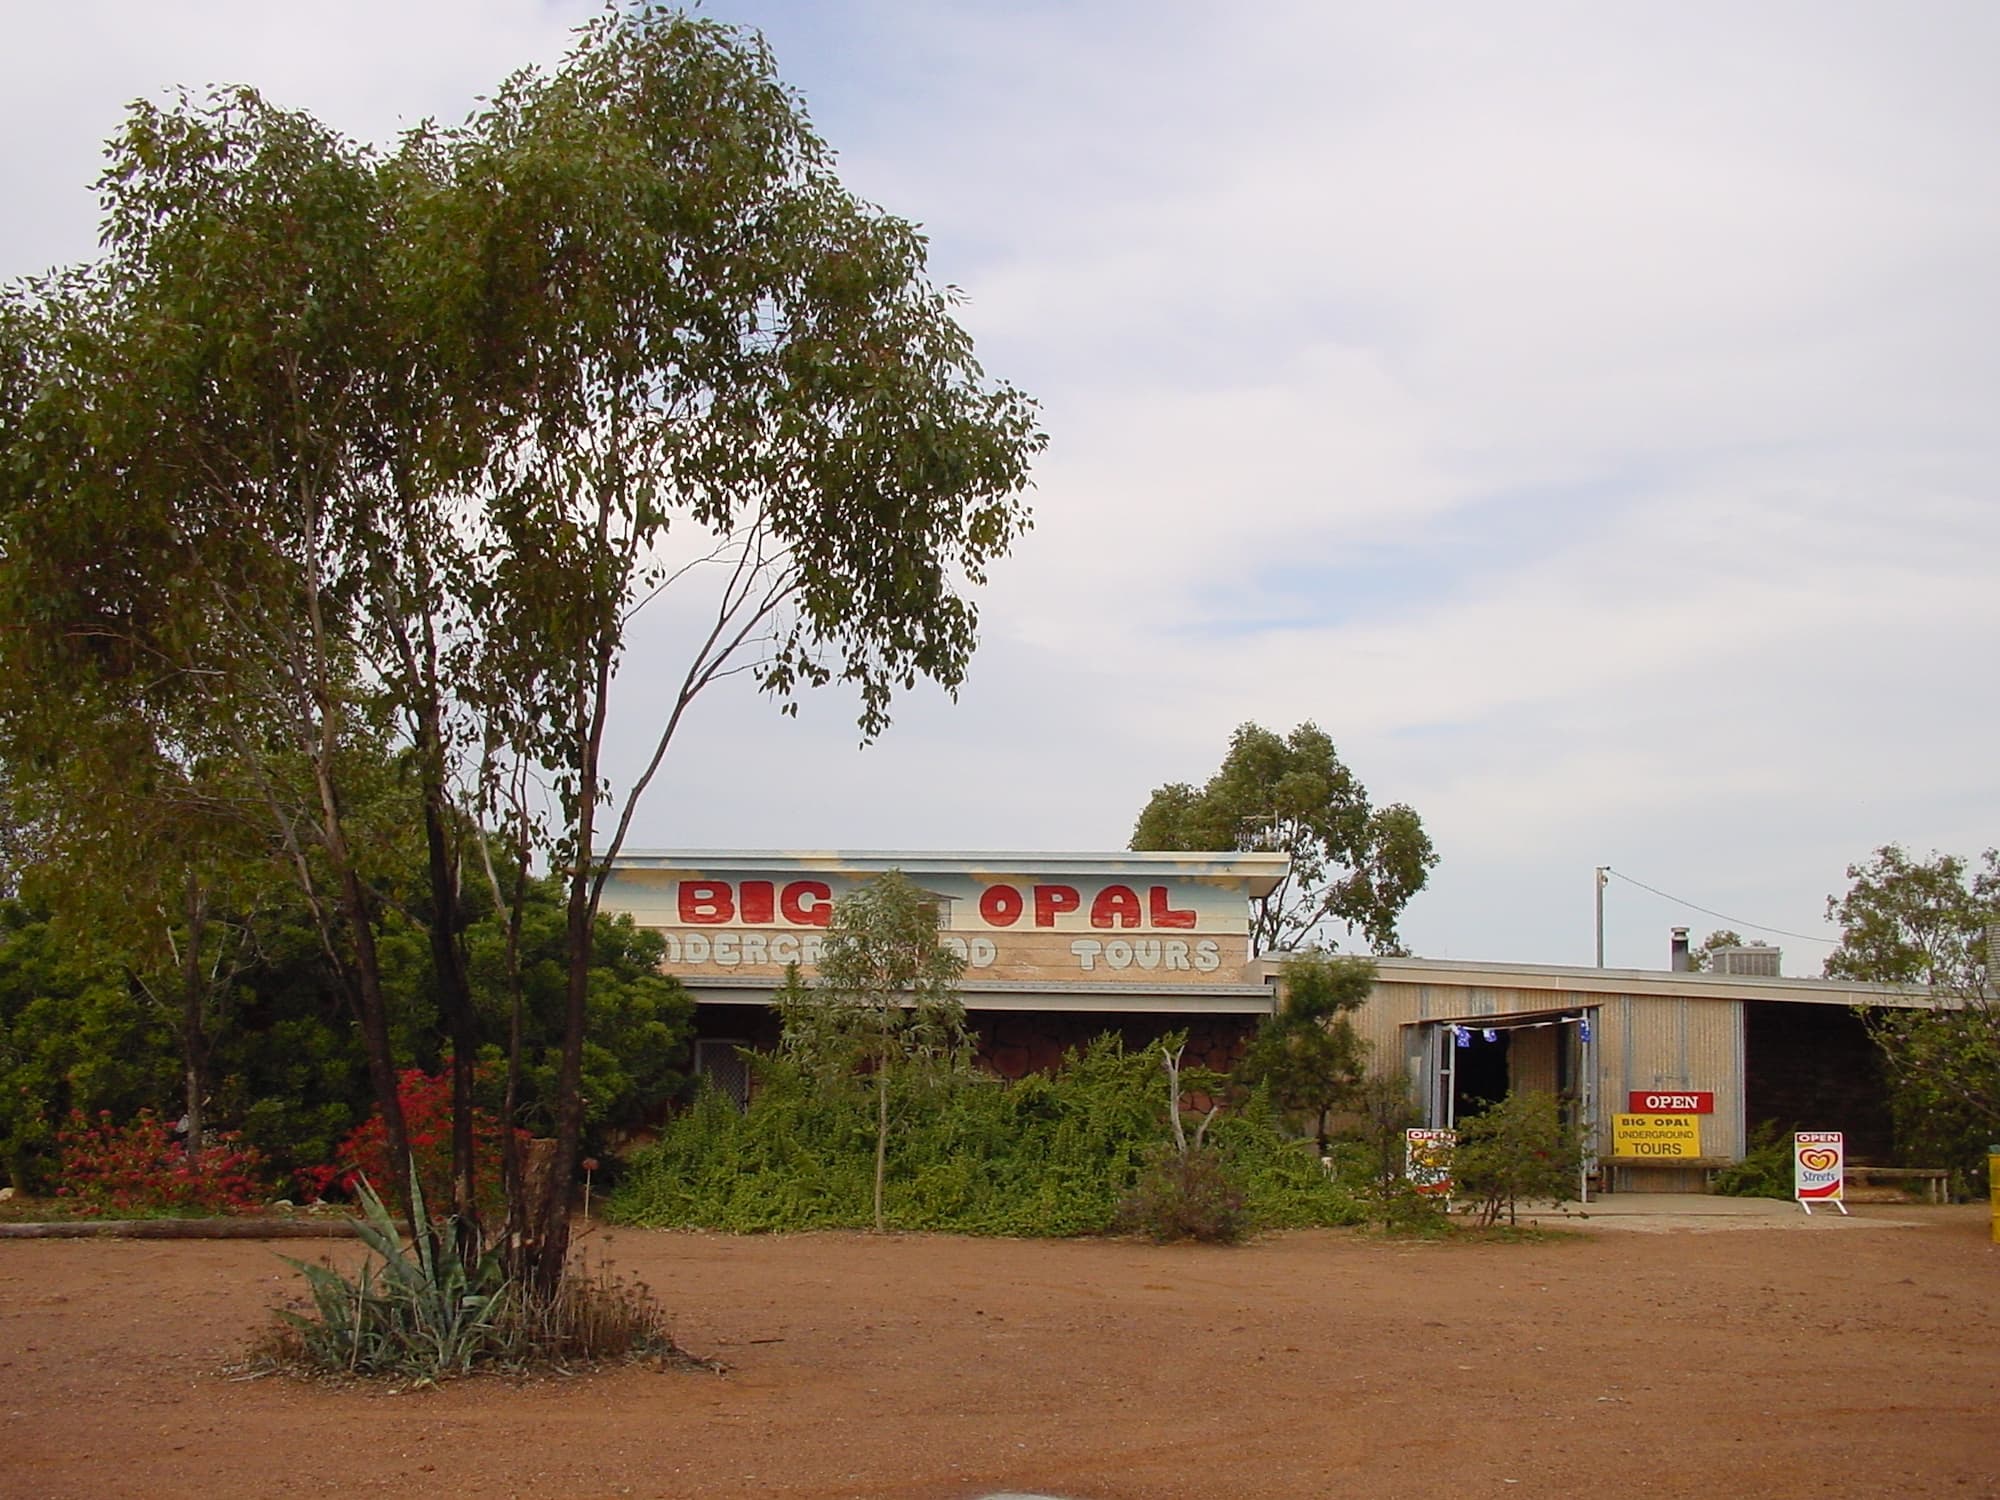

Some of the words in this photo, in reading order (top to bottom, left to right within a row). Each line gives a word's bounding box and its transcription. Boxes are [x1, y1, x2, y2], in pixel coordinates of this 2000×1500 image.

[677, 880, 832, 927] BIG
[979, 884, 1197, 930] OPAL
[1071, 939, 1222, 972] TOURS
[1645, 1095, 1699, 1109] OPEN
[1622, 1118, 1646, 1127] BIG
[1654, 1118, 1690, 1127] OPAL
[1618, 1130, 1695, 1140] UNDERGROUND
[1798, 1134, 1839, 1142] OPEN
[1632, 1142, 1682, 1155] TOURS
[1802, 1171, 1836, 1182] Streets
